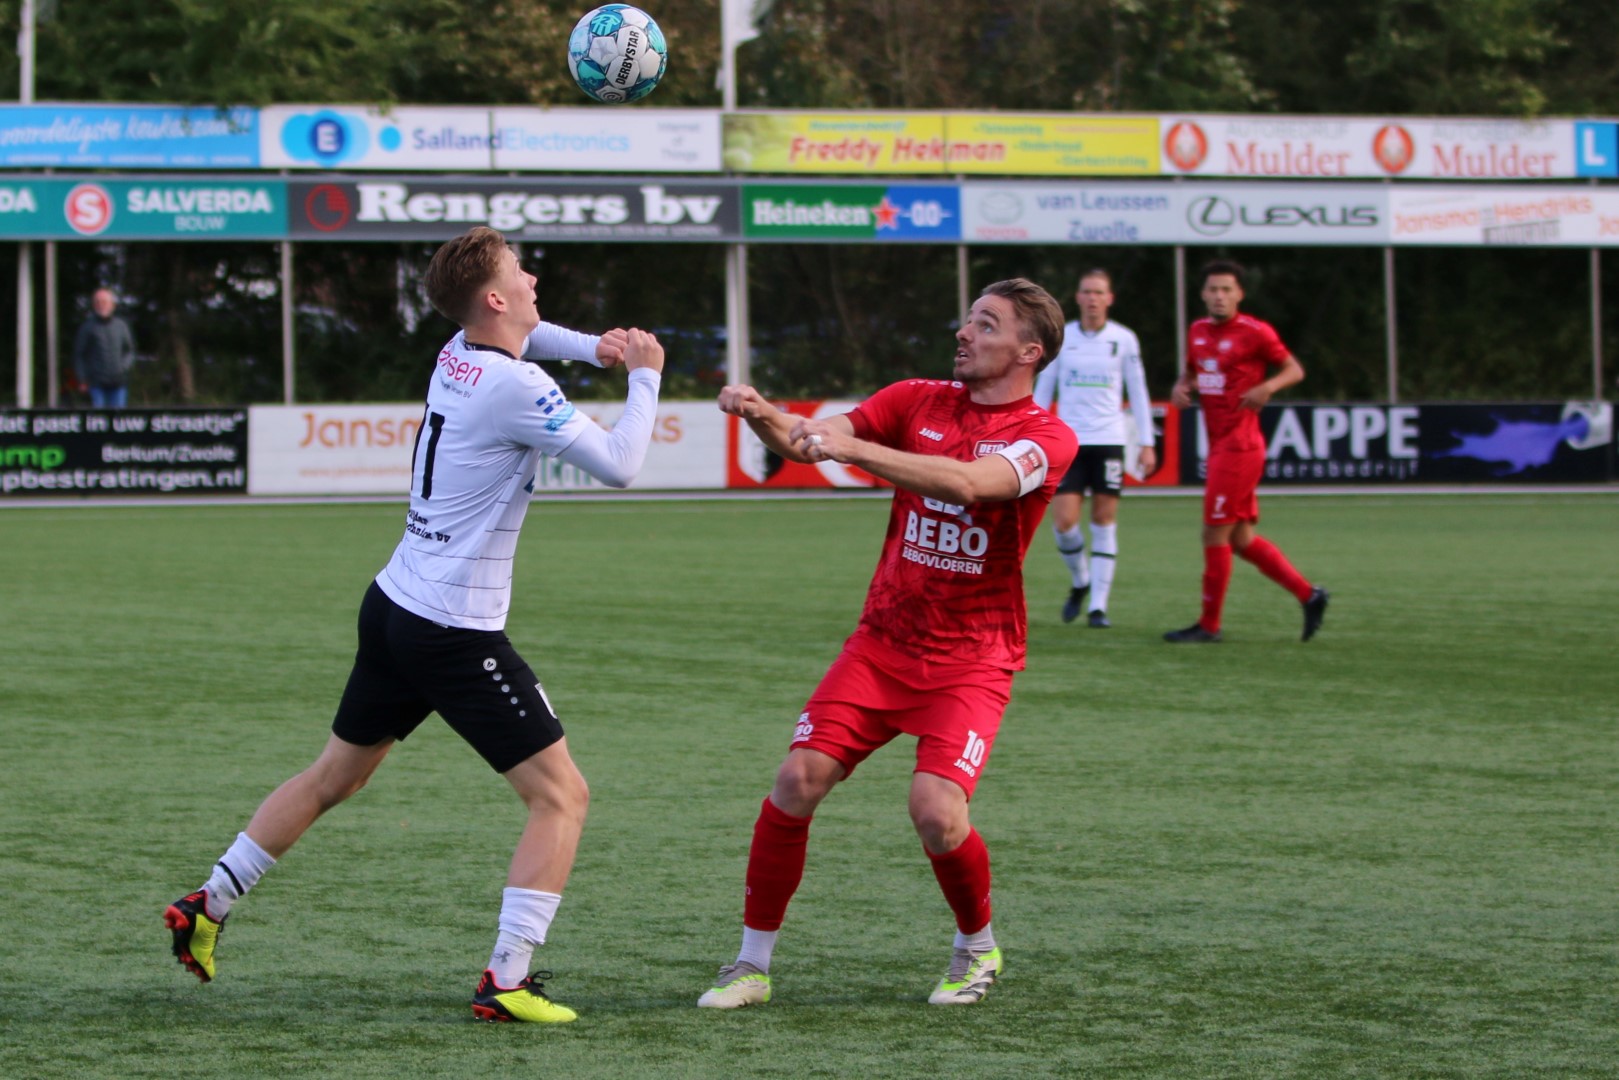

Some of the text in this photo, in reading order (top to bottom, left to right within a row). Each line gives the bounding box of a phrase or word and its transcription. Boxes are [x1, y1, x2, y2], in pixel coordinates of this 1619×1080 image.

[615, 30, 640, 86] DERBYSTAR
[788, 136, 1007, 168] Freddy Hekman
[1225, 140, 1352, 177] Mulder
[1431, 143, 1557, 178] Mulder
[127, 187, 273, 213] SALVERDA
[356, 183, 722, 232] Rengers bv
[752, 199, 871, 226] Heineken
[1036, 191, 1169, 211] van Leussen
[174, 215, 226, 231] BOUW
[1239, 205, 1379, 227] LEXUS
[1068, 219, 1139, 241] Zwolle
[33, 415, 81, 436] past
[86, 413, 109, 433] in
[113, 416, 146, 433] uw
[101, 444, 237, 464] Berkum/Zwolle
[903, 510, 989, 557] BEBO
[902, 546, 984, 575] BEBOVLOEREN
[961, 729, 985, 768] 10
[953, 758, 976, 778] JAKO
